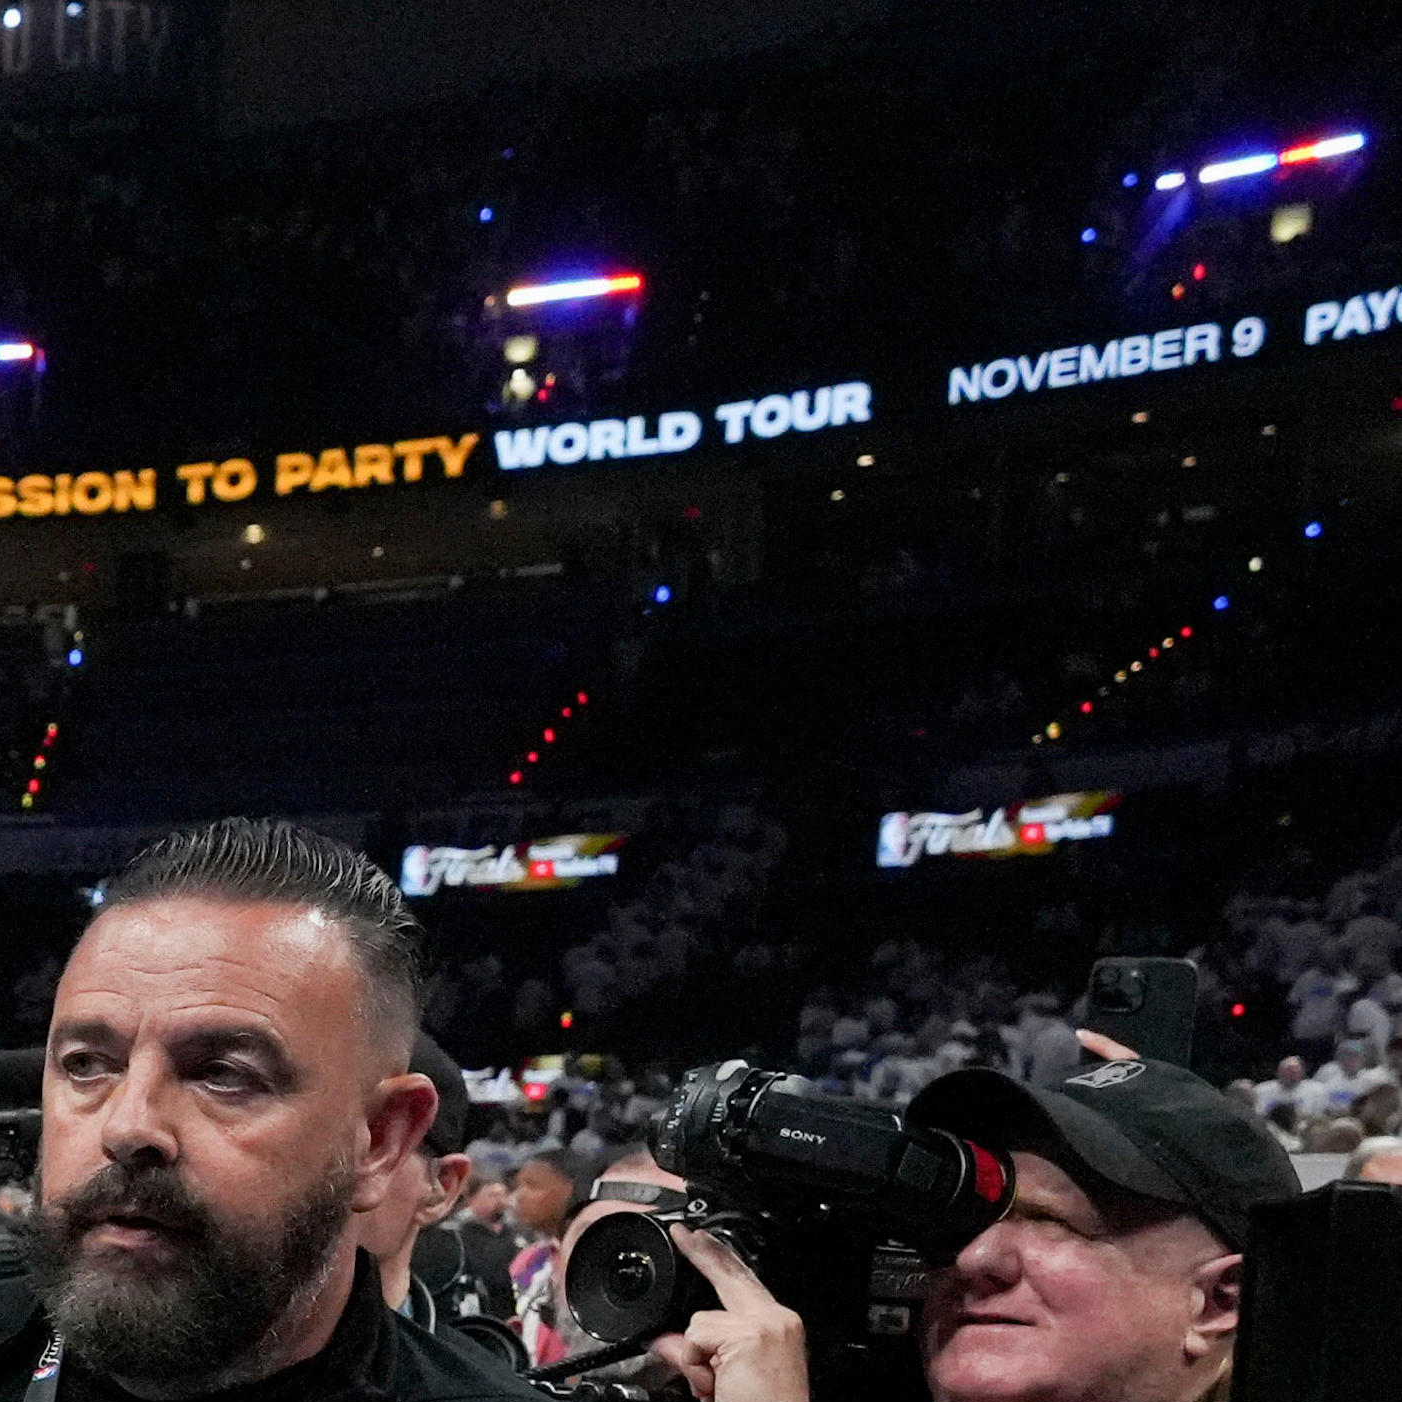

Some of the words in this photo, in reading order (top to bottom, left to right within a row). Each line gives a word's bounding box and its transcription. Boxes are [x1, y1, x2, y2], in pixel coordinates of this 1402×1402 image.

[948, 323, 1222, 404] NOVEMBER
[1232, 316, 1264, 357] 9
[177, 458, 257, 504] TO
[275, 433, 480, 496] PARTY
[494, 411, 702, 470] WORLD
[715, 381, 872, 444] TOUR
[779, 1127, 828, 1146] SONY
